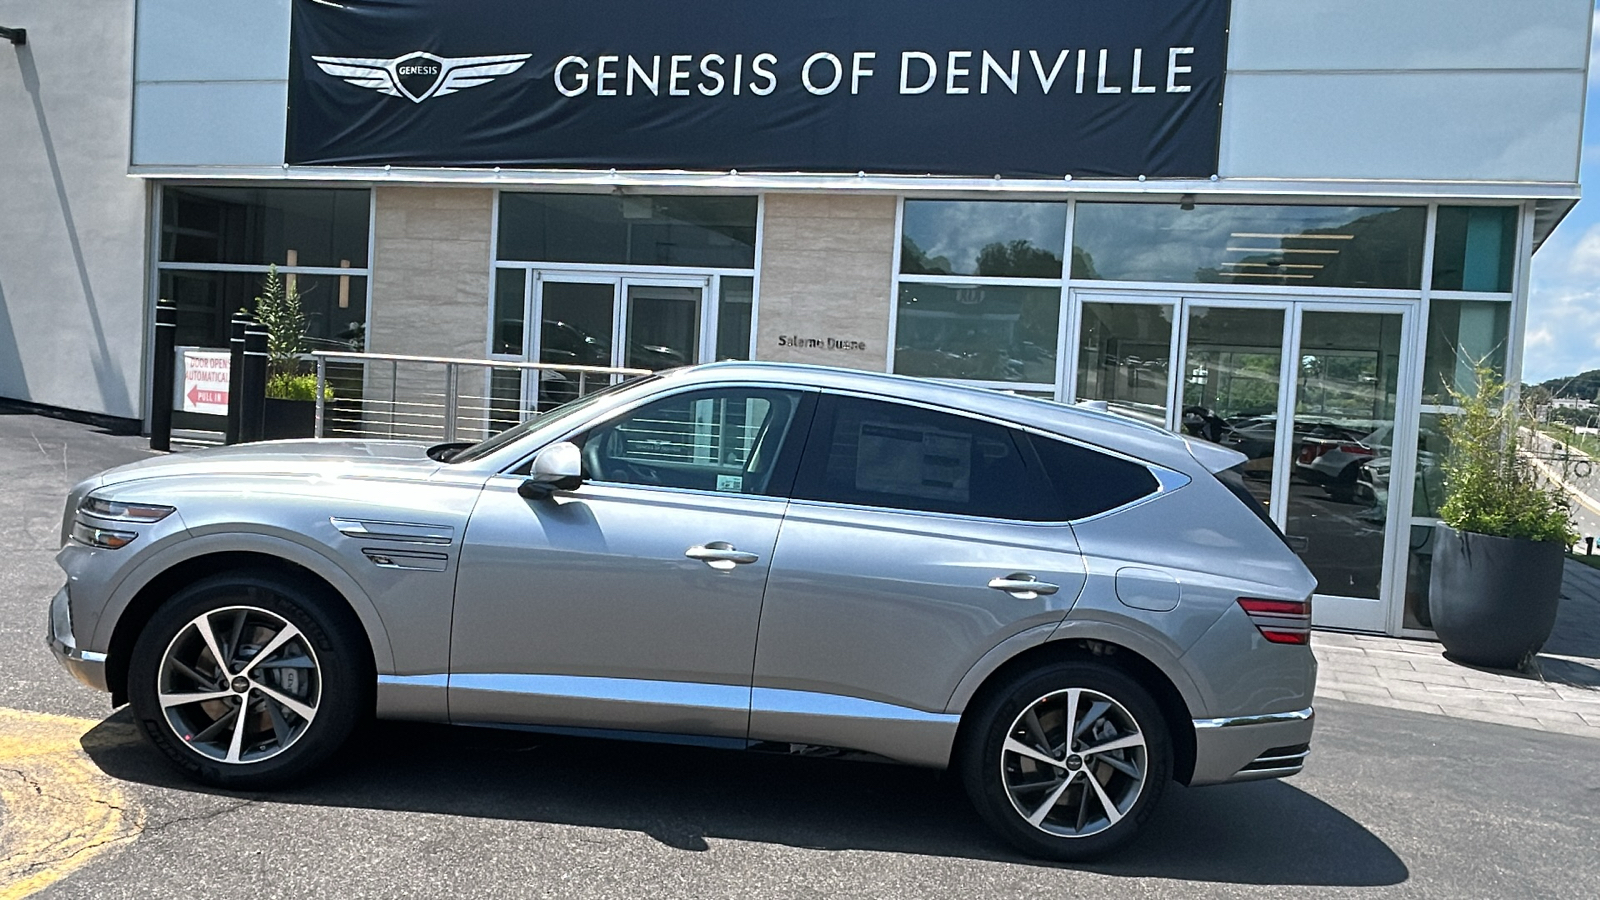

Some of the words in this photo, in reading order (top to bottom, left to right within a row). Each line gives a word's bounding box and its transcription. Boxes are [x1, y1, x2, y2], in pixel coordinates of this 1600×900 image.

[399, 66, 438, 75] GENESIS
[553, 53, 778, 97] GENESIS
[801, 51, 876, 96] OF
[899, 47, 1195, 95] DENVILLE
[190, 358, 208, 368] DOOR
[198, 391, 213, 402] PULL
